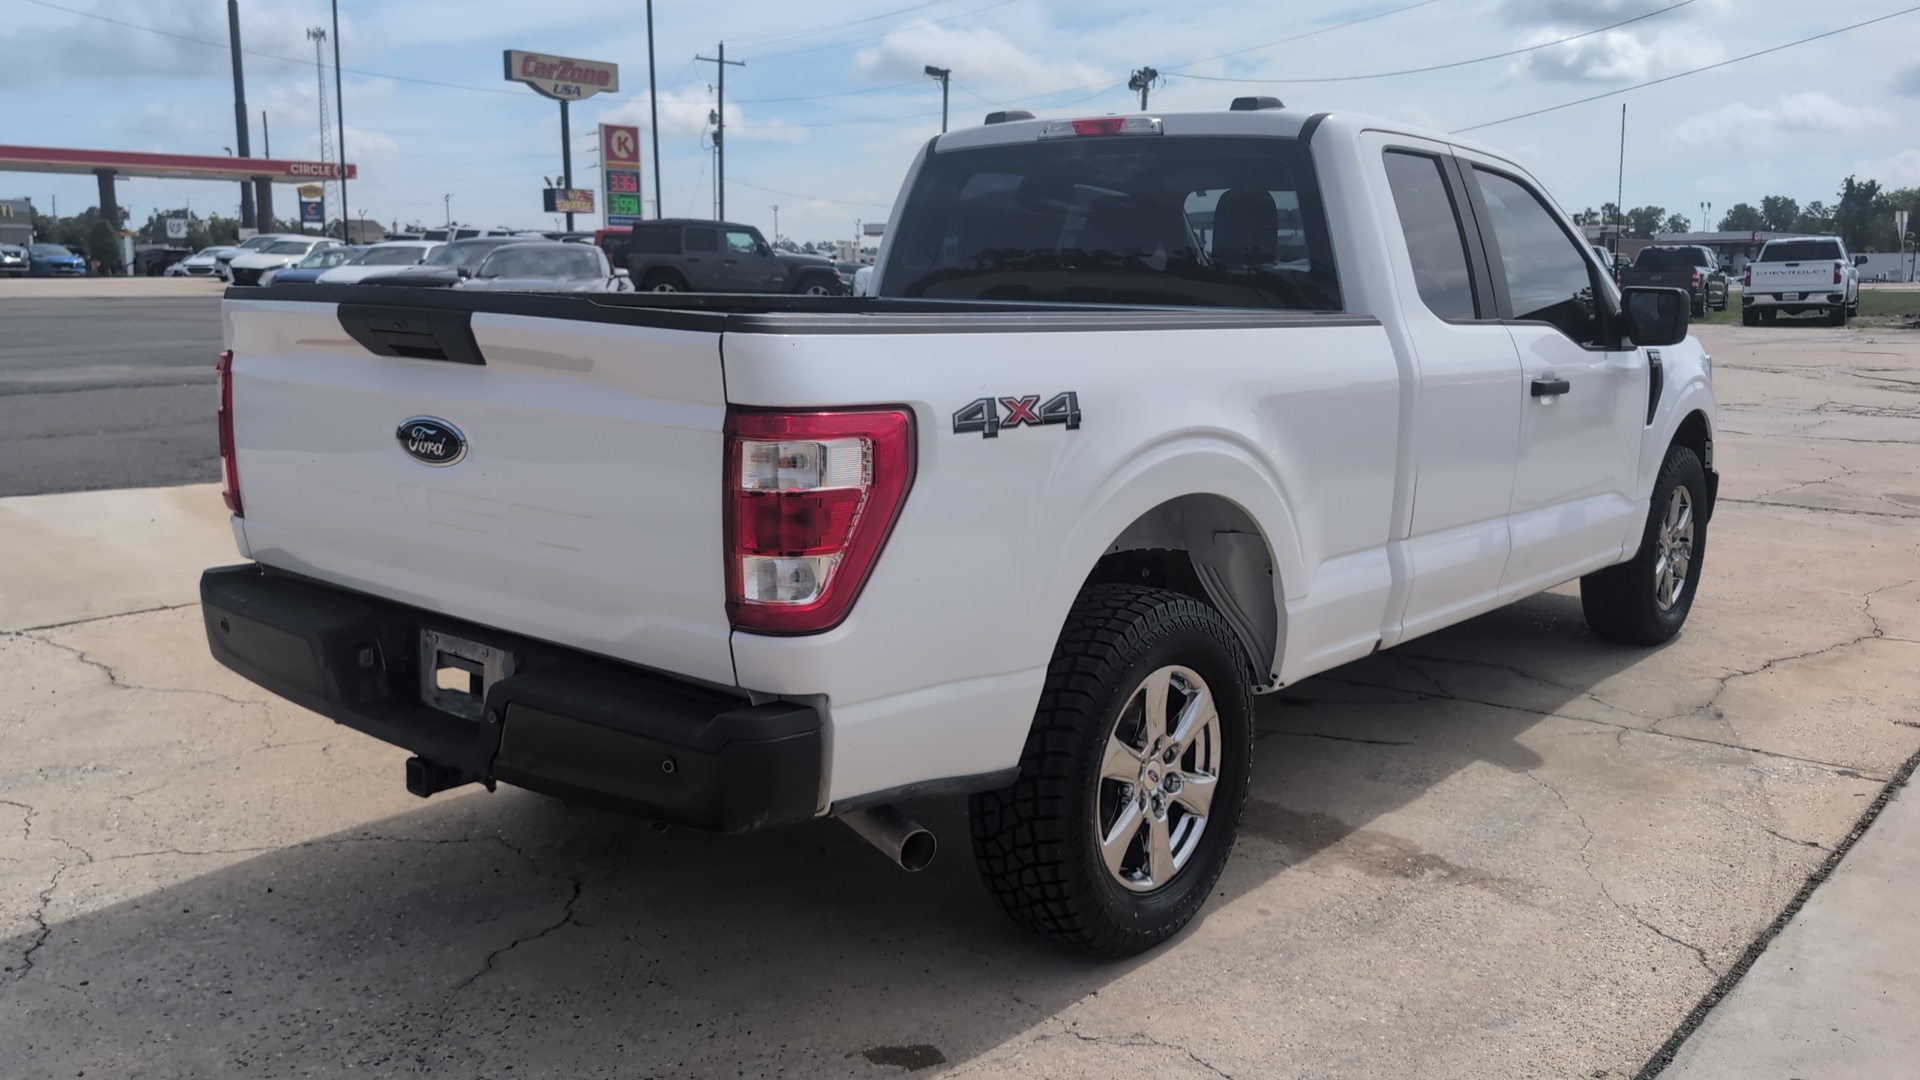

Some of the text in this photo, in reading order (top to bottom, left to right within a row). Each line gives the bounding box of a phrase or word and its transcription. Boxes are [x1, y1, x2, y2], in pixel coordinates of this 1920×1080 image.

[521, 55, 611, 87] CarZone
[553, 84, 581, 97] USA
[617, 136, 630, 155] K
[291, 163, 332, 176] CIRCLE
[408, 425, 446, 456] Ford
